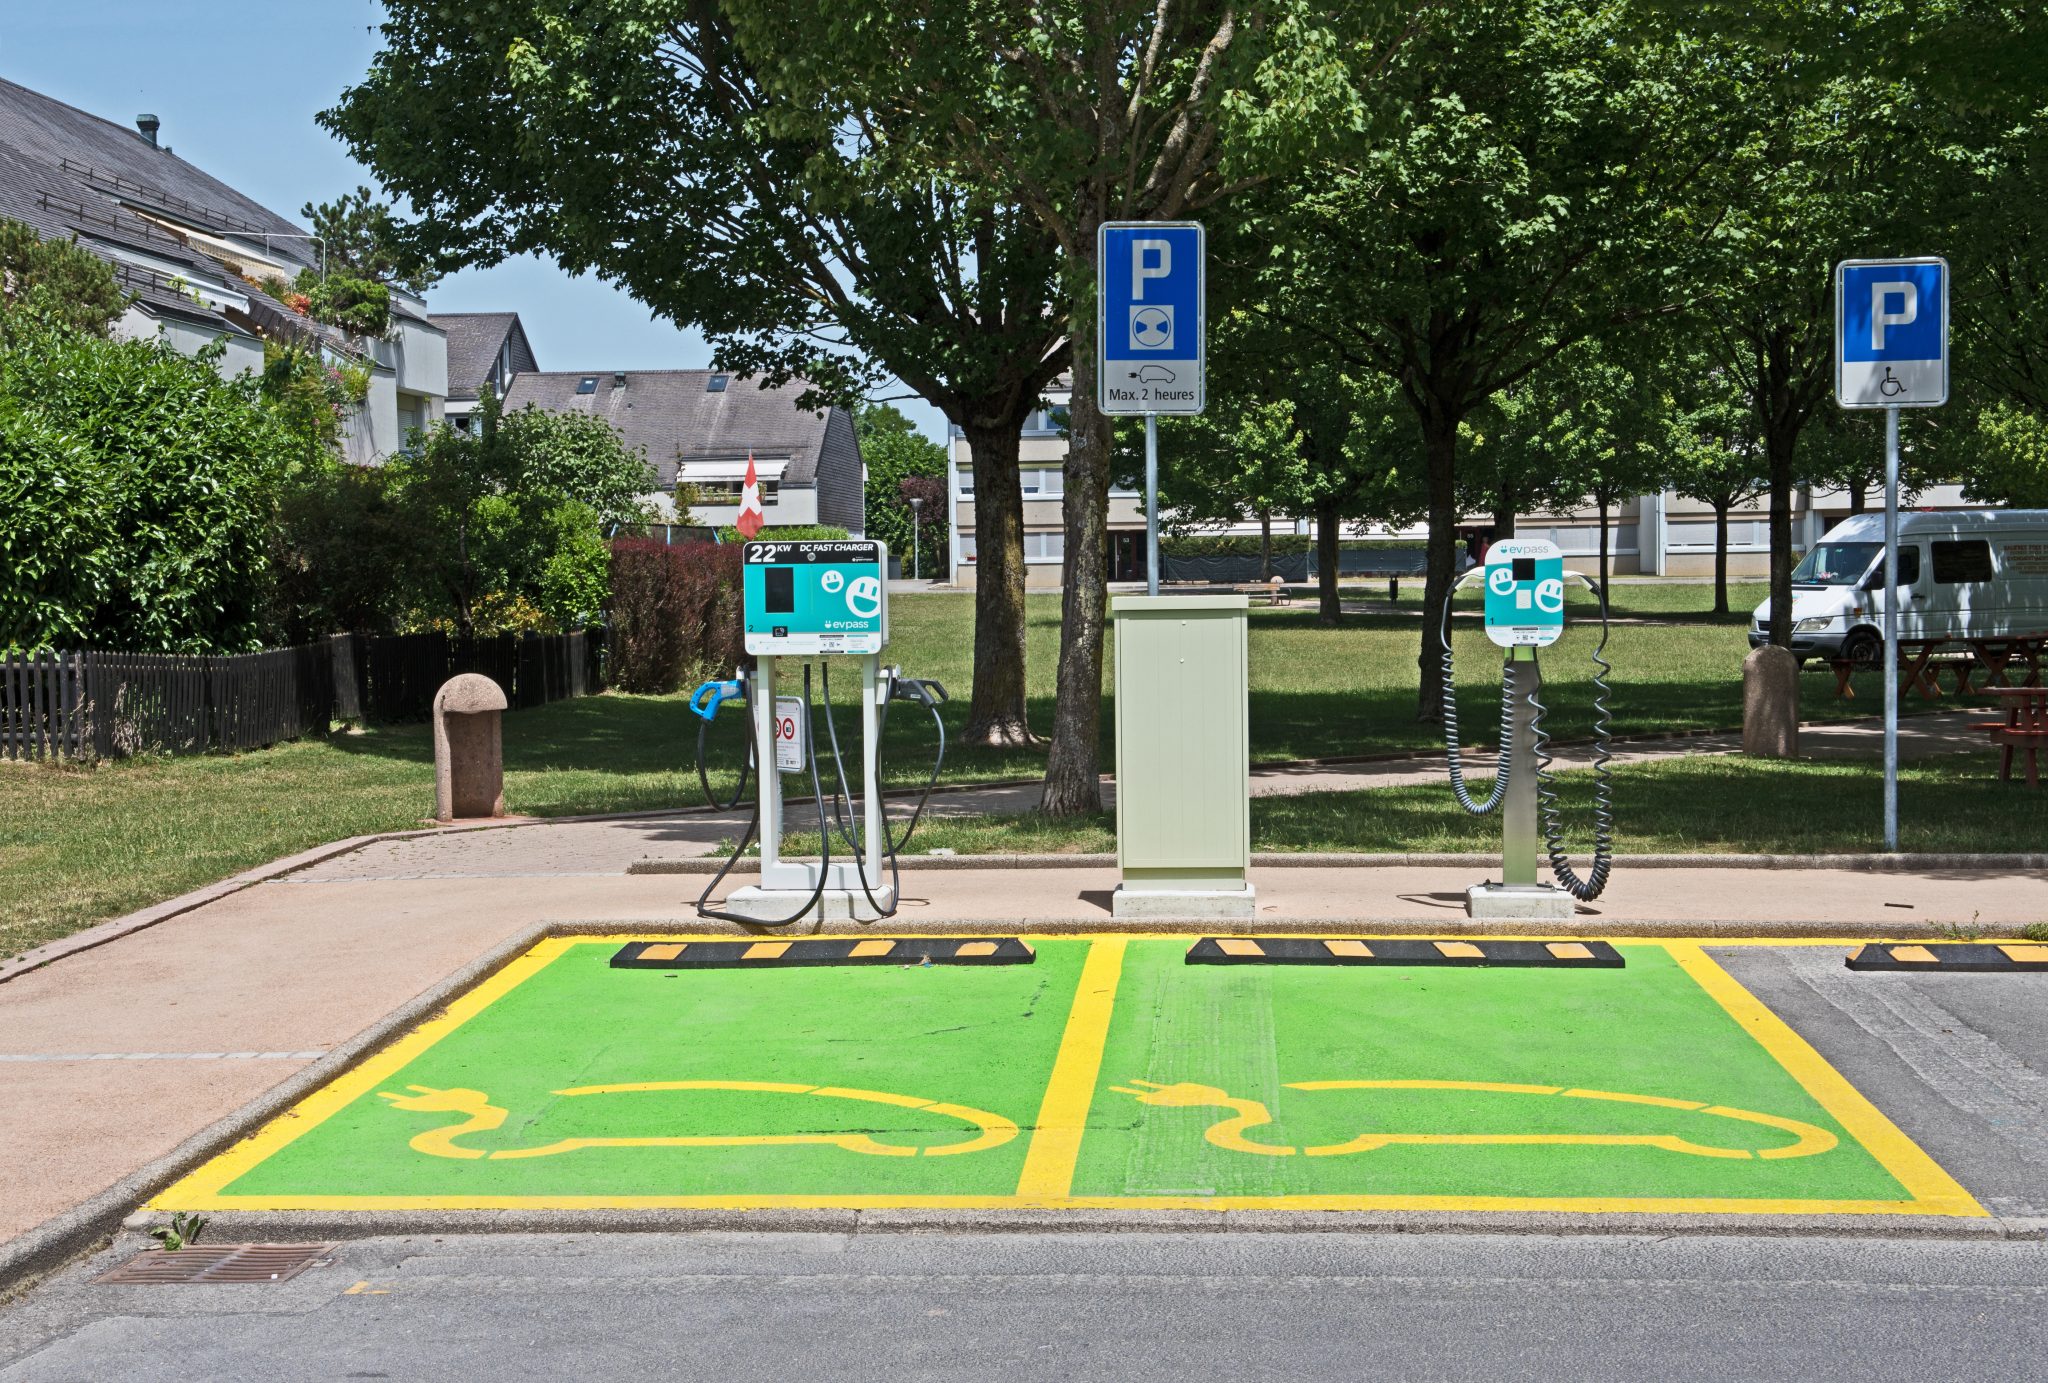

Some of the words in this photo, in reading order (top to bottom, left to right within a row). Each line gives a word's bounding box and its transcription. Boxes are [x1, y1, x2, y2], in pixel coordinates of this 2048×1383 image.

[1132, 239, 1172, 300] P
[1872, 281, 1917, 350] P
[1109, 388, 1139, 401] Max.
[1141, 388, 1149, 401] 2
[1155, 387, 1195, 401] heures
[749, 544, 777, 563] 22
[776, 544, 792, 552] KW
[799, 544, 812, 552] DC
[813, 544, 834, 552] FAST
[834, 543, 874, 551] CHARGER
[1509, 545, 1549, 555] evpass
[832, 620, 869, 630] evpass
[1489, 617, 1495, 625] 1
[748, 624, 754, 633] 2
